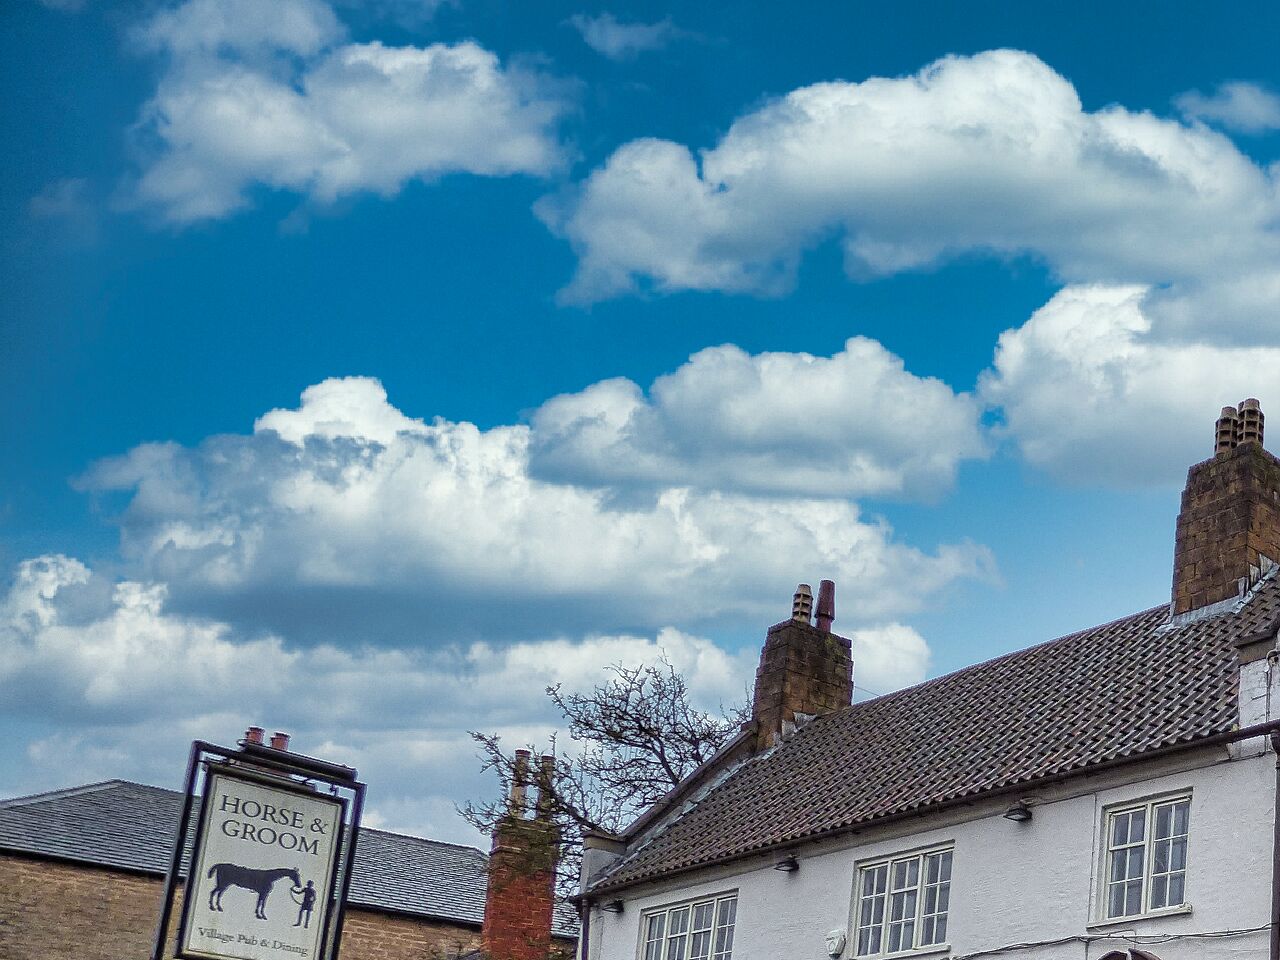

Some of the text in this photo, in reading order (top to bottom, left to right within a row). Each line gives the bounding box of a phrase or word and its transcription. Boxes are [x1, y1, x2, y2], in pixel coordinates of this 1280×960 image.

[219, 795, 329, 835] HORSE &
[222, 819, 320, 856] GROOM
[198, 927, 309, 957] Village Pub & Dining
